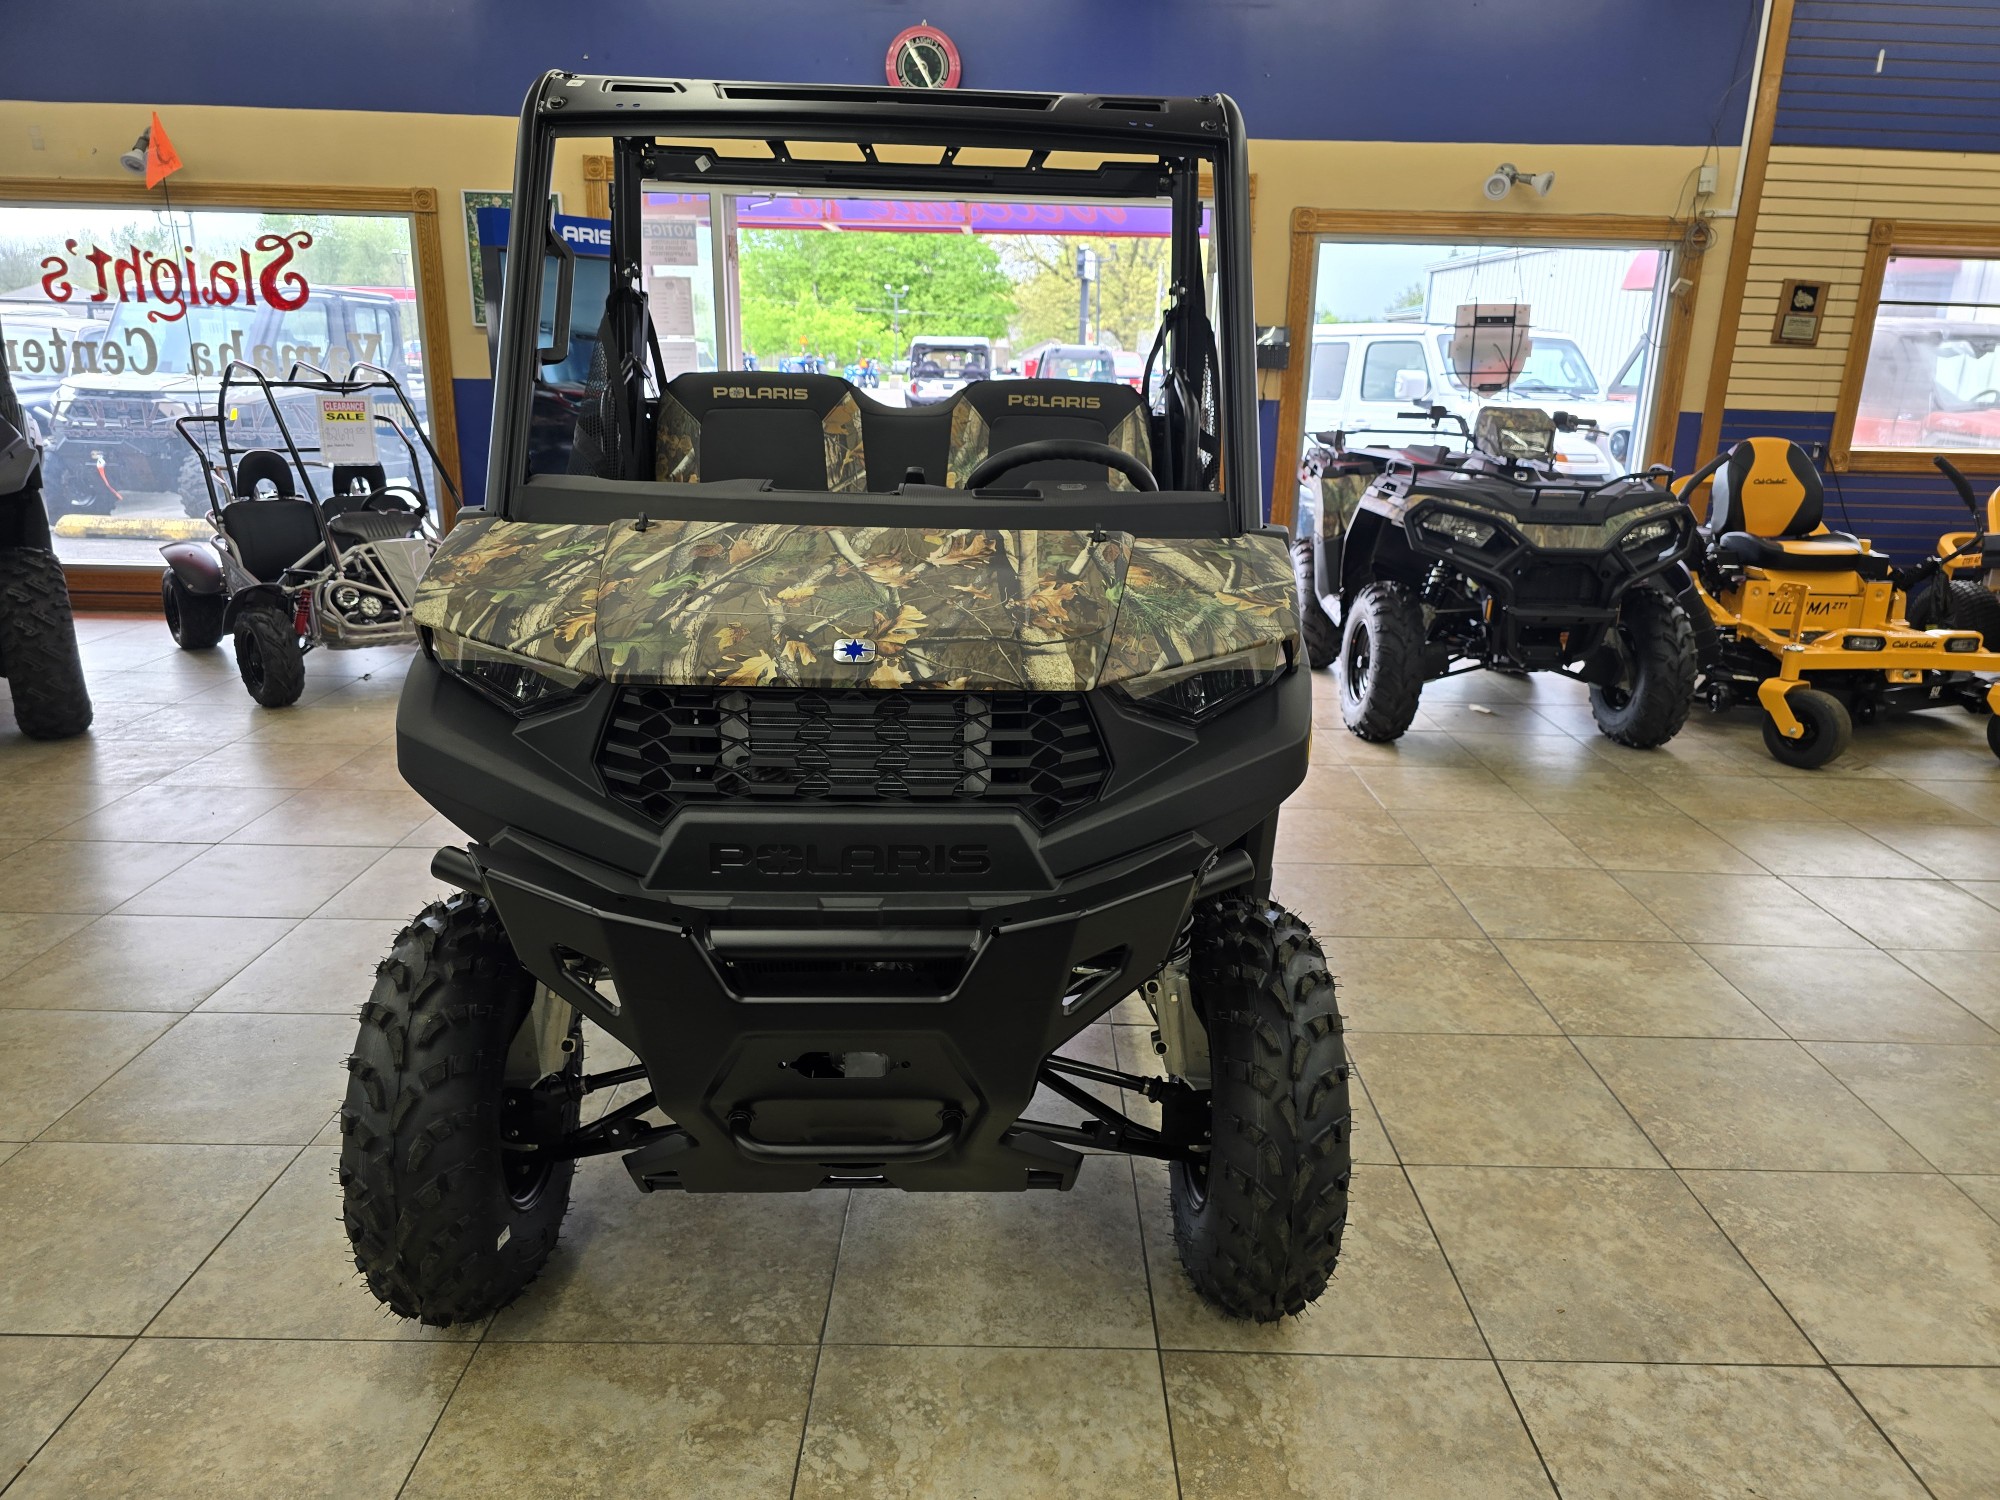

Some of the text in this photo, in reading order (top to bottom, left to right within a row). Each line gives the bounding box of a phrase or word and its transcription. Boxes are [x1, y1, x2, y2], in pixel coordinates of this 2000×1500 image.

[561, 226, 611, 245] ARIS
[712, 386, 808, 401] POLARIS
[324, 402, 365, 411] CLEARANCE
[1007, 394, 1101, 409] POLARIS
[326, 412, 365, 420] SALE
[1773, 601, 1830, 615] ULMA
[1892, 640, 1937, 648] Cub Cadet
[709, 842, 992, 876] POLARIS
